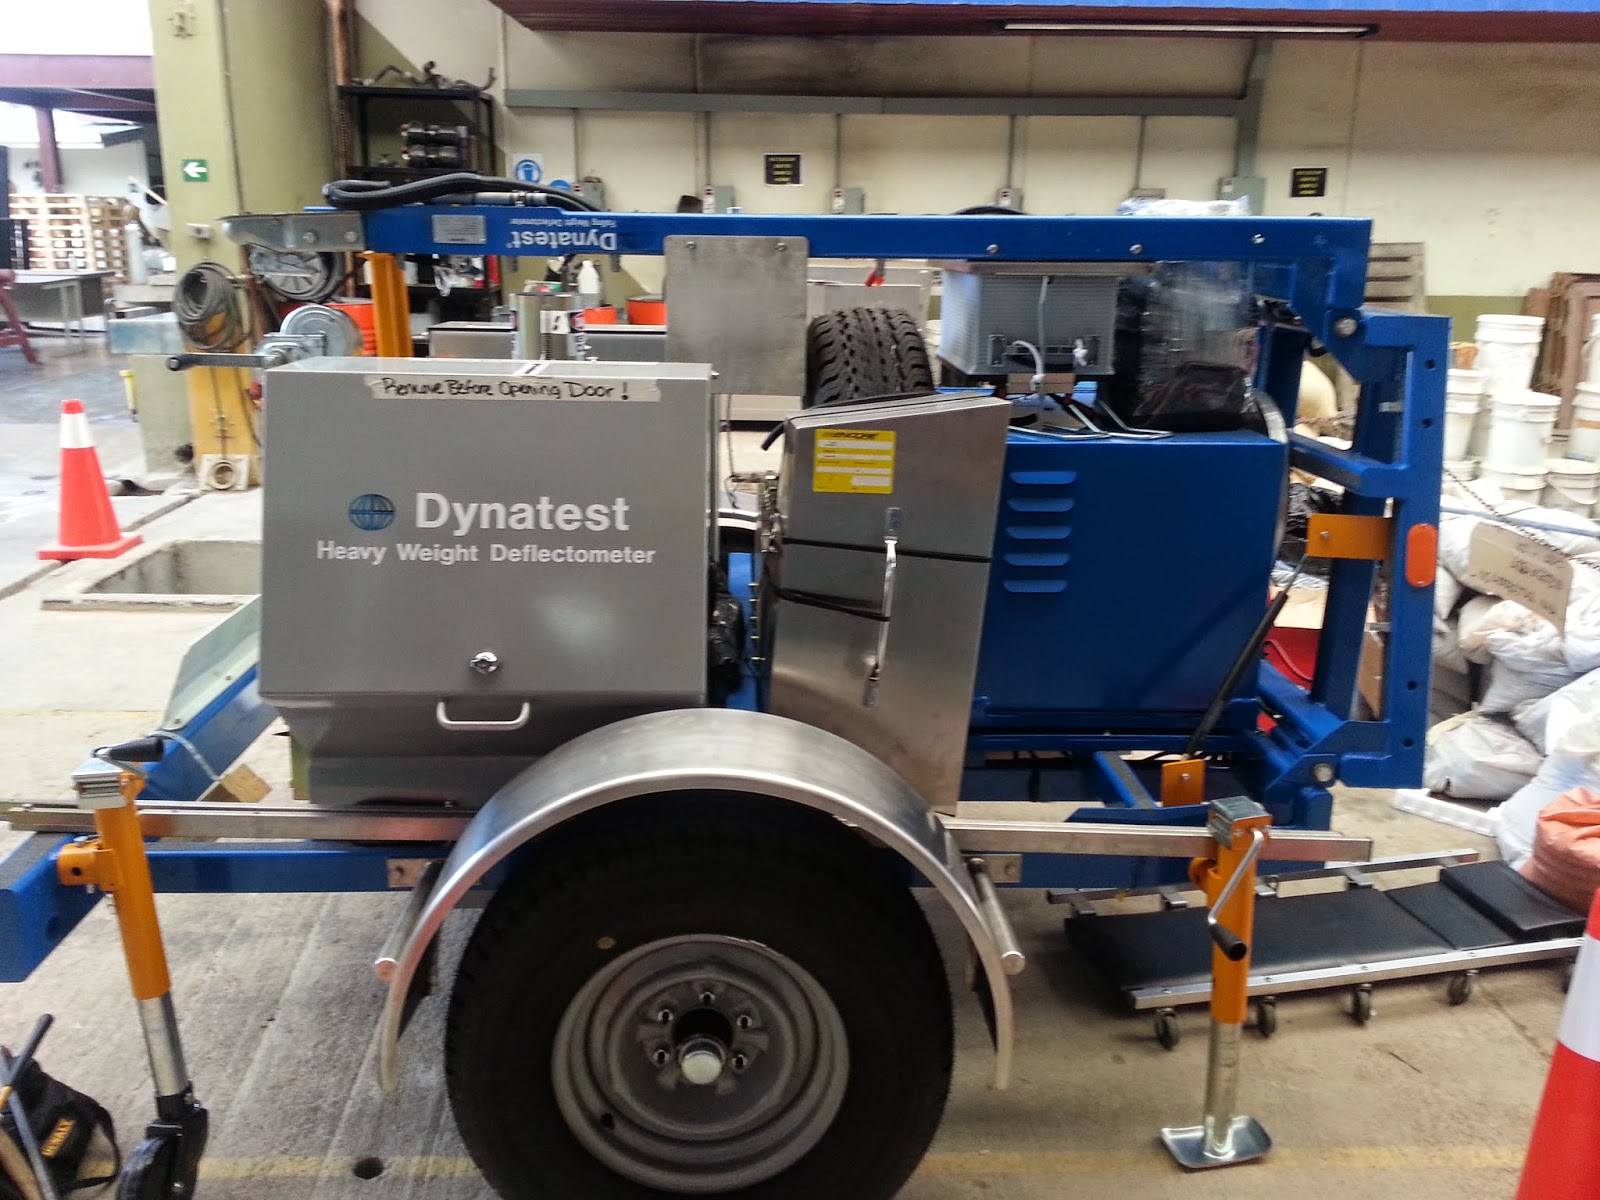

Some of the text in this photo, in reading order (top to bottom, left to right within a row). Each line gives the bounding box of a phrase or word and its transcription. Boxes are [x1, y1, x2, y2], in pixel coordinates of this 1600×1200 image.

[381, 377, 443, 396] Remove
[444, 379, 493, 396] Before
[499, 381, 561, 399] Opening
[563, 381, 615, 398] Door
[414, 492, 631, 536] Dynatest
[316, 540, 656, 566] Heavy Weight Deflectometer
